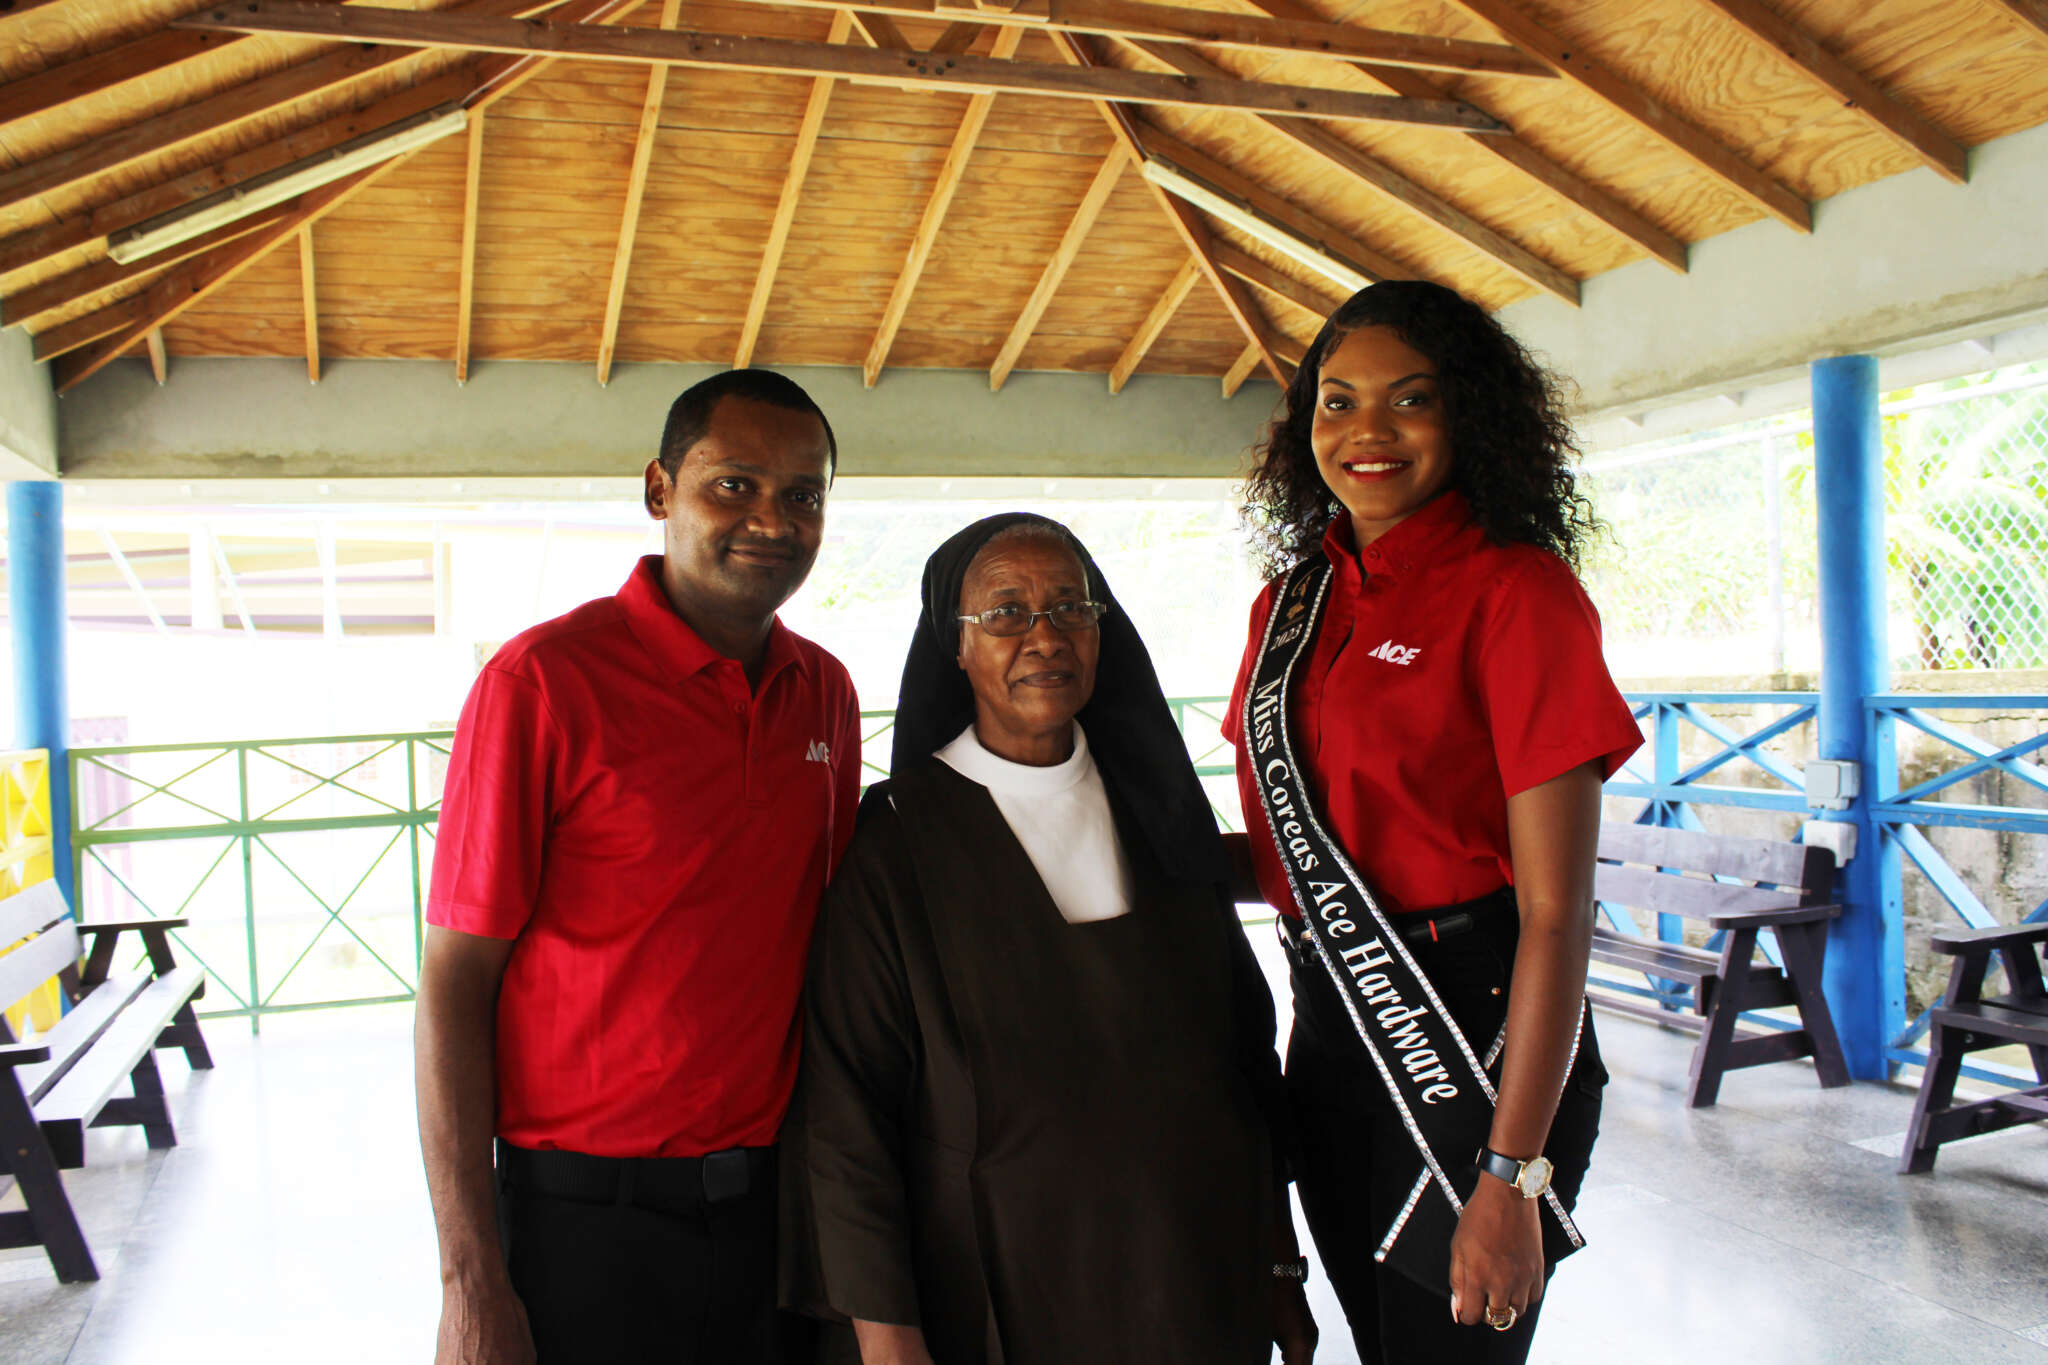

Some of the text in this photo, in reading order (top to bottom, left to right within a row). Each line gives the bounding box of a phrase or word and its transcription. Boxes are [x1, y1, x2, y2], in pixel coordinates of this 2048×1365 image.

[1367, 639, 1421, 666] ACE
[1253, 674, 1458, 1105] Miss Coreas Ace Hardware
